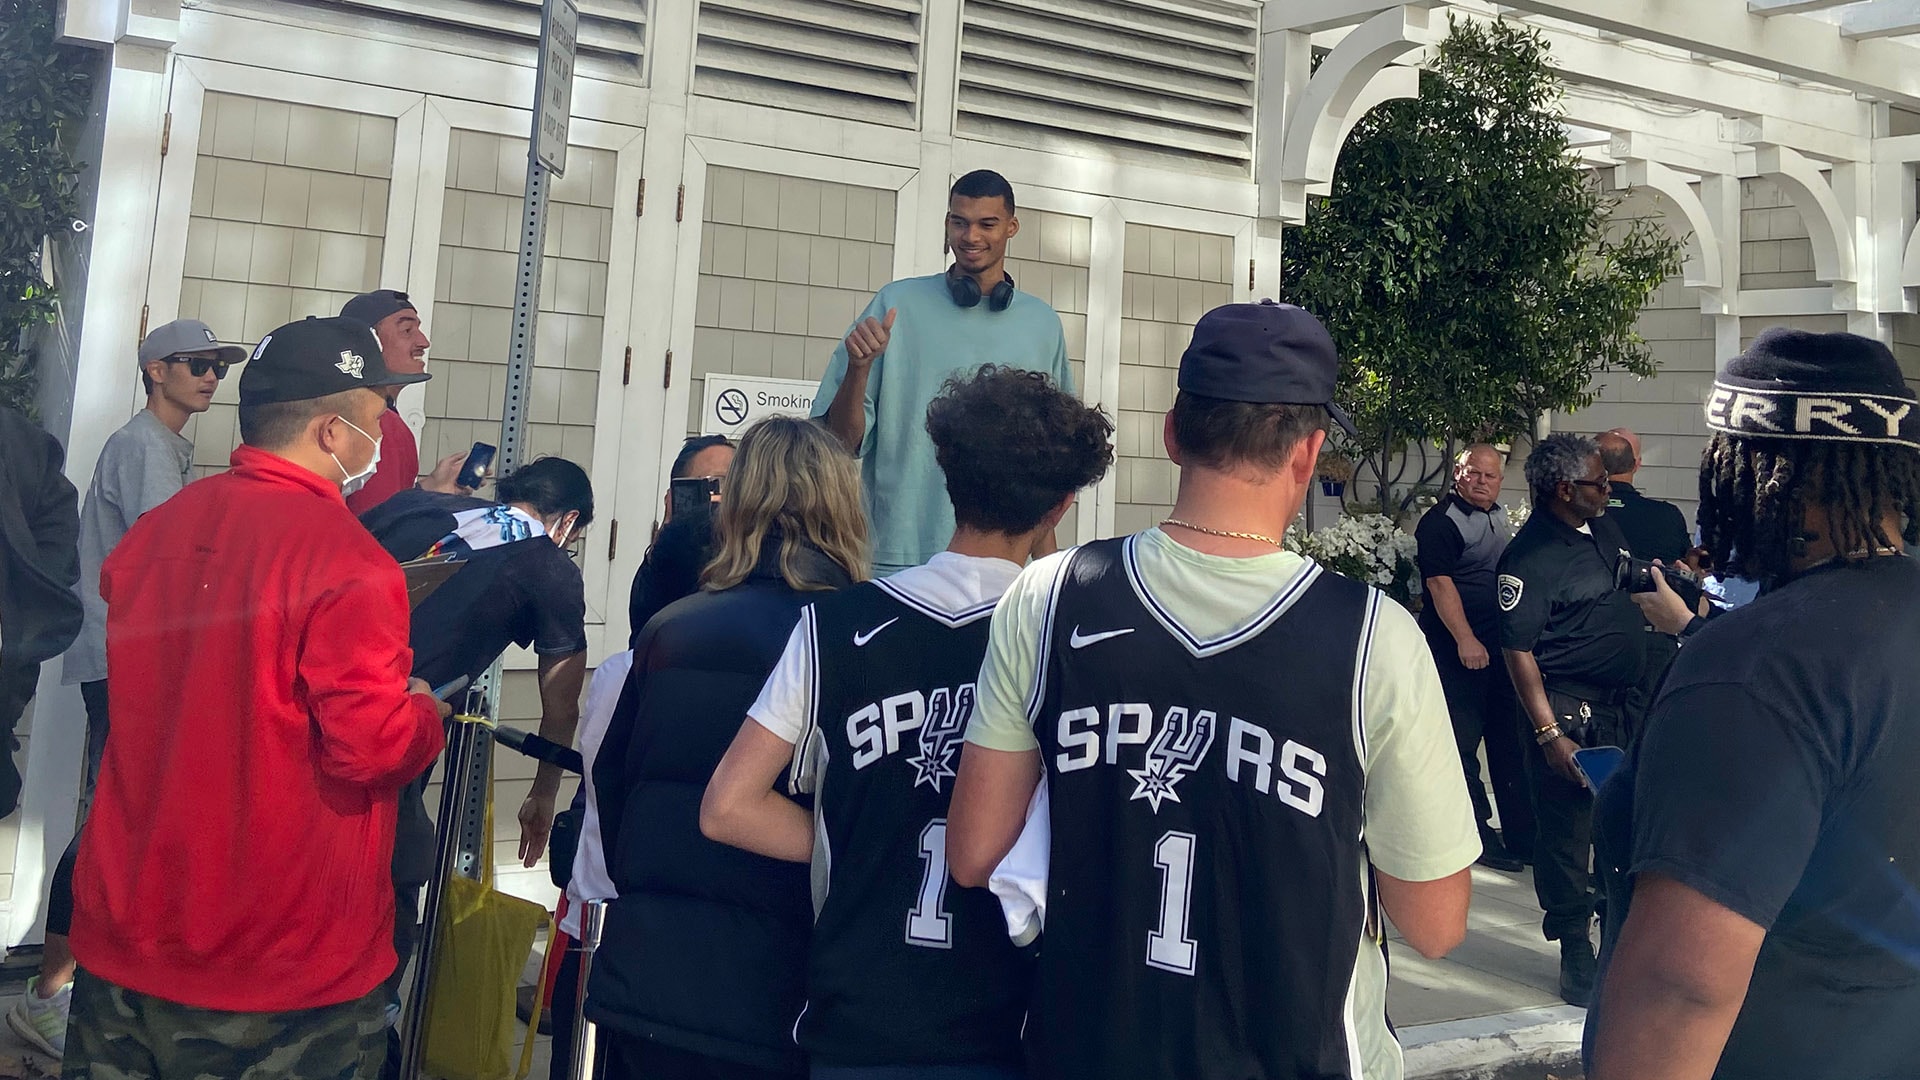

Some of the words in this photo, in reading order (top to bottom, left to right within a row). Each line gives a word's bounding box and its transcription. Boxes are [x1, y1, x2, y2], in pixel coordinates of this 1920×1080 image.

[757, 391, 814, 409] Smokin
[846, 683, 976, 793] SPU
[1056, 703, 1327, 817] SPURS
[905, 818, 953, 949] 1
[1146, 830, 1198, 976] 1
